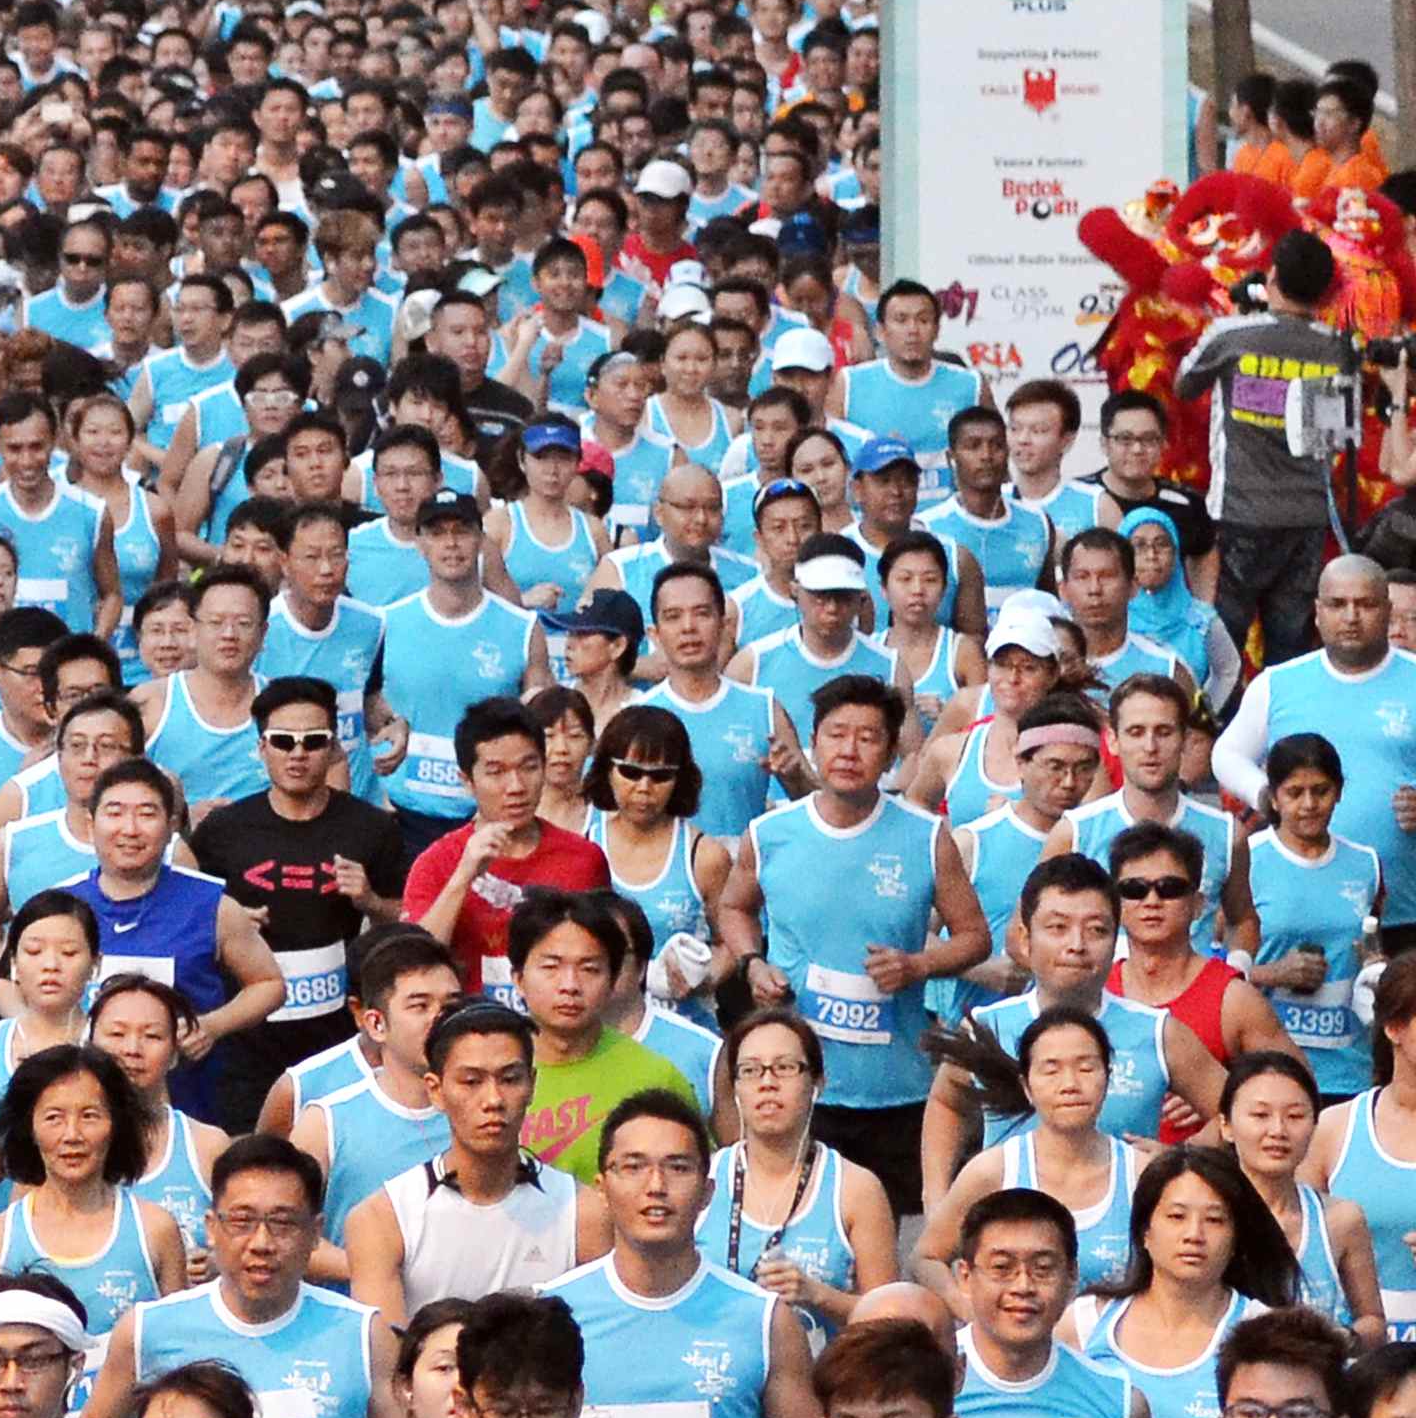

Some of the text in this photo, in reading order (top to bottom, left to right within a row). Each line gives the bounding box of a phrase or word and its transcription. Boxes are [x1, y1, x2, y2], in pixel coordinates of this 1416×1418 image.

[1013, 0, 1067, 12] PLUS
[1001, 178, 1065, 198] Bedok
[1014, 199, 1080, 220] Point
[990, 284, 1049, 300] CLASS
[816, 994, 881, 1030] 7992
[1284, 1006, 1347, 1037] 3399
